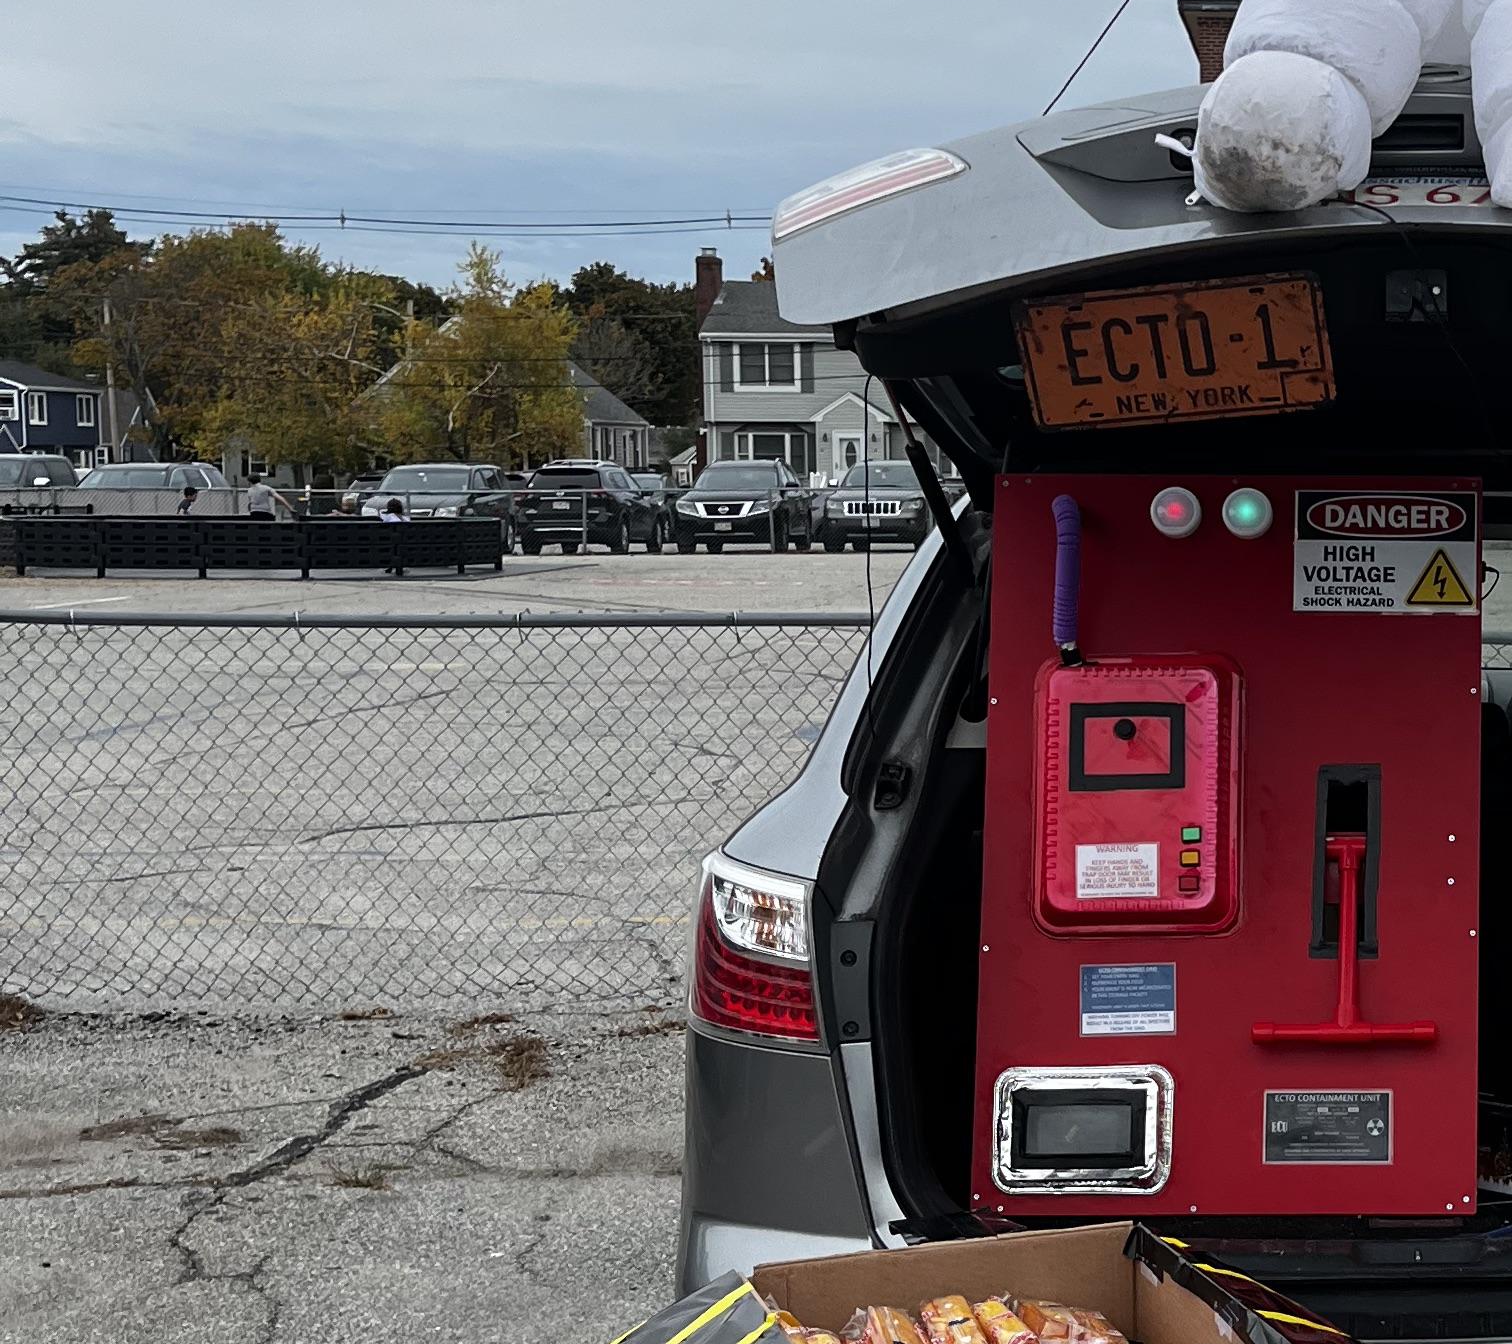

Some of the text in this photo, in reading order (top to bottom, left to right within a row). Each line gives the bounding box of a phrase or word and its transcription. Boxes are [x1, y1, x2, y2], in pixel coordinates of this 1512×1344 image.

[1115, 384, 1255, 415] NEW YORK
[1323, 503, 1450, 530] DANGER
[1323, 545, 1376, 563] HIGH
[1302, 565, 1397, 584] VOLTAGE
[1314, 586, 1384, 596] ELECTRICAL
[1302, 596, 1395, 608] SHOCK HAZARD
[1096, 845, 1138, 853] WARNING
[1274, 1093, 1381, 1102] ECTO CONTAINMENT UNIT
